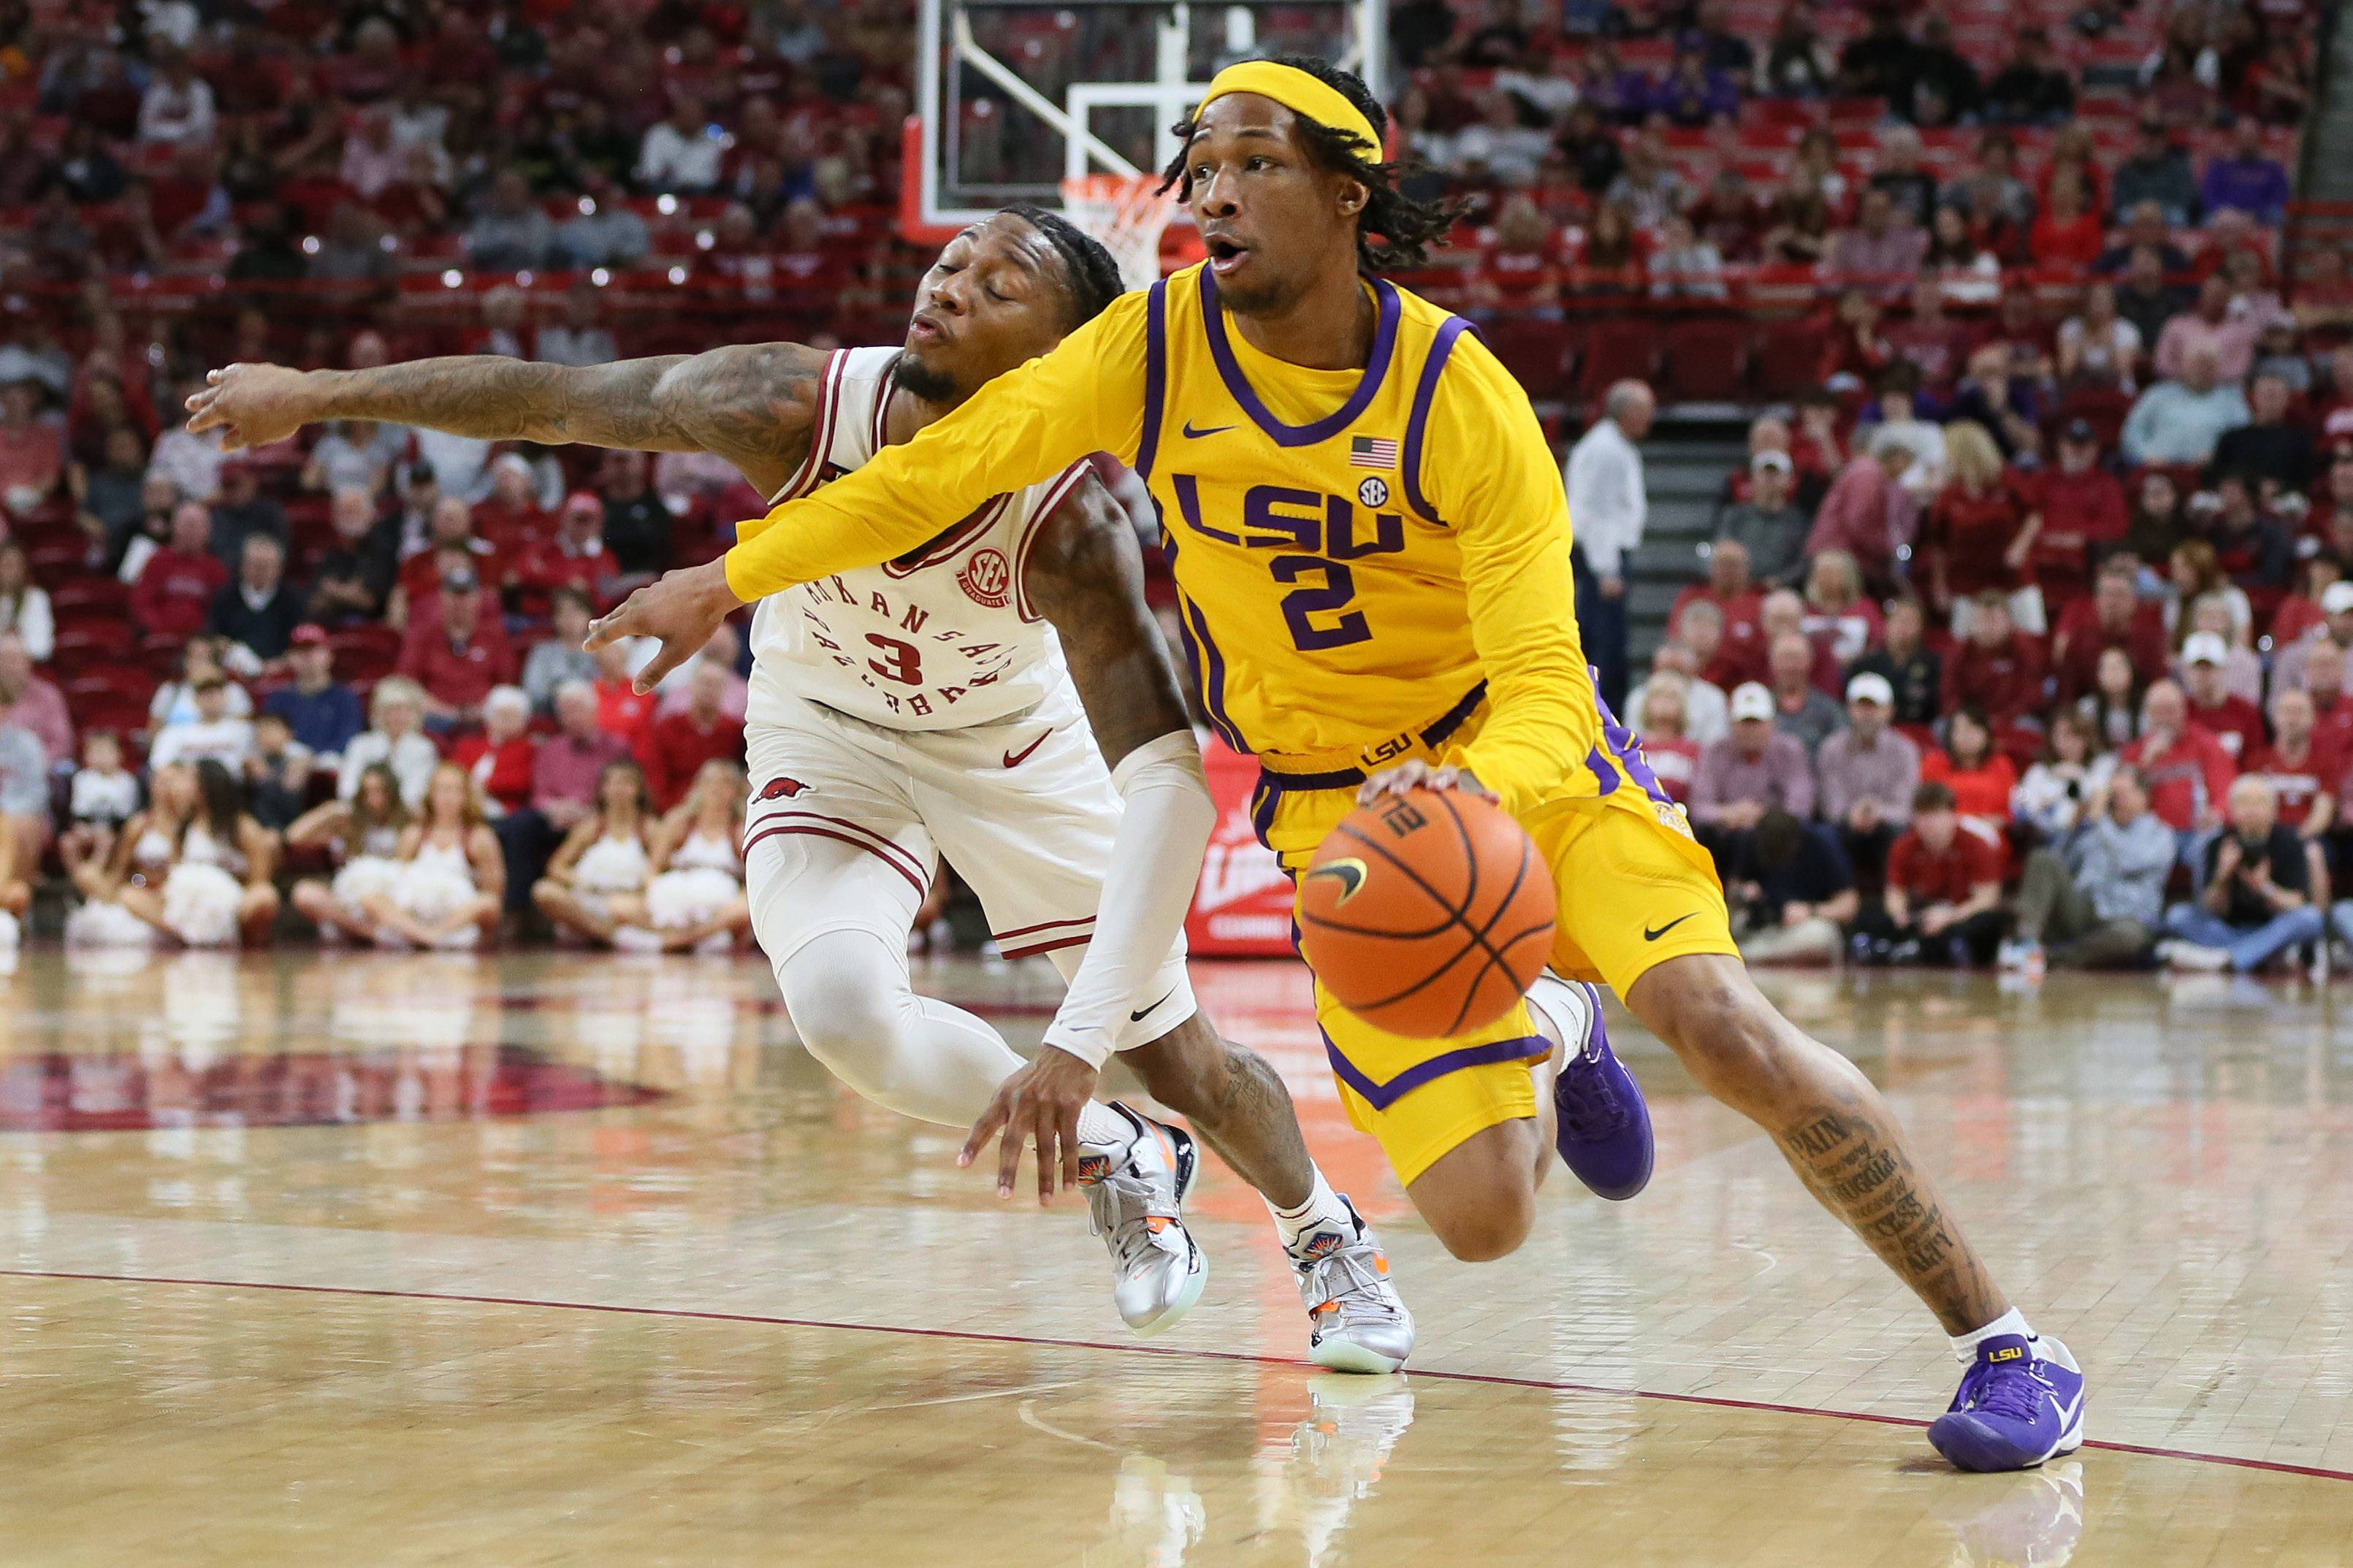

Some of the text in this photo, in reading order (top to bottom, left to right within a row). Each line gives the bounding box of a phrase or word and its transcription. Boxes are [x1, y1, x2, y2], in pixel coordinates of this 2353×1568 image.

[1359, 478, 1387, 507] SEC
[1171, 473, 1406, 560] LSU
[971, 552, 1007, 593] SEC
[961, 581, 1002, 607] GRADUATE
[1268, 555, 1374, 651] 2
[864, 632, 923, 686] 3
[1359, 732, 1414, 767] LSU
[1988, 1346, 2024, 1364] LSU
